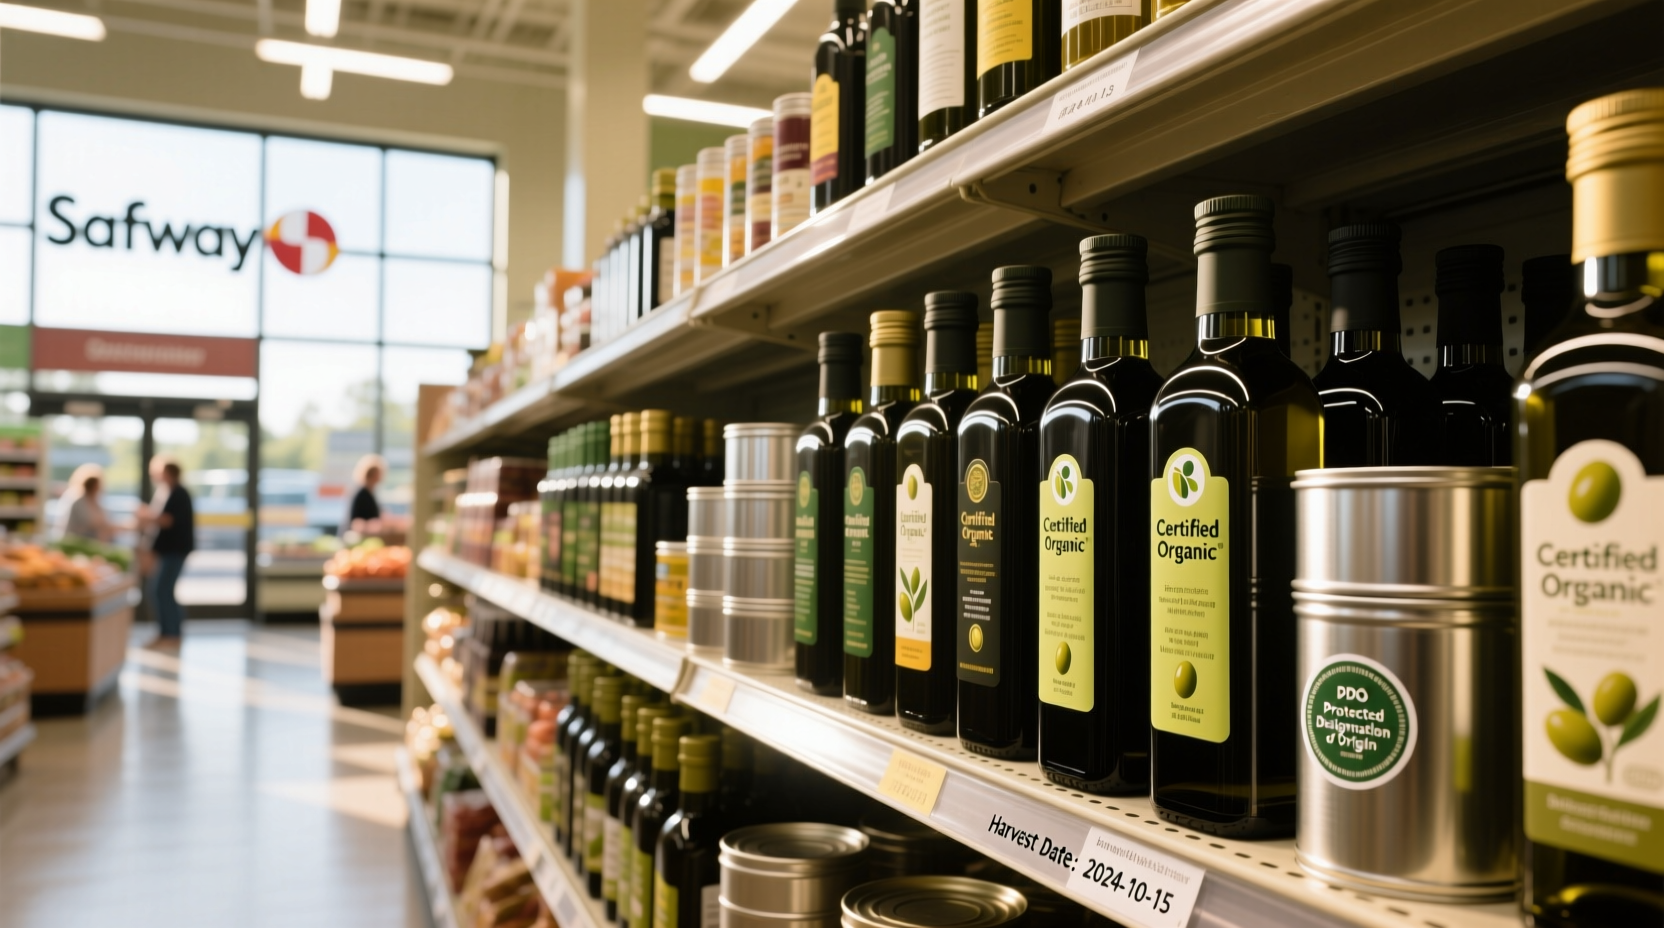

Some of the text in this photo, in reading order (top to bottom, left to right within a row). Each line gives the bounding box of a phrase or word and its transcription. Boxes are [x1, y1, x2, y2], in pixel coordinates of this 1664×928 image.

[47, 195, 259, 271] Safway
[1156, 518, 1219, 538] Certified
[1537, 542, 1658, 573] Certified
[988, 814, 1039, 852] Harvest
[1038, 836, 1079, 872] Date:
[1082, 858, 1175, 914] 2024-10-15
